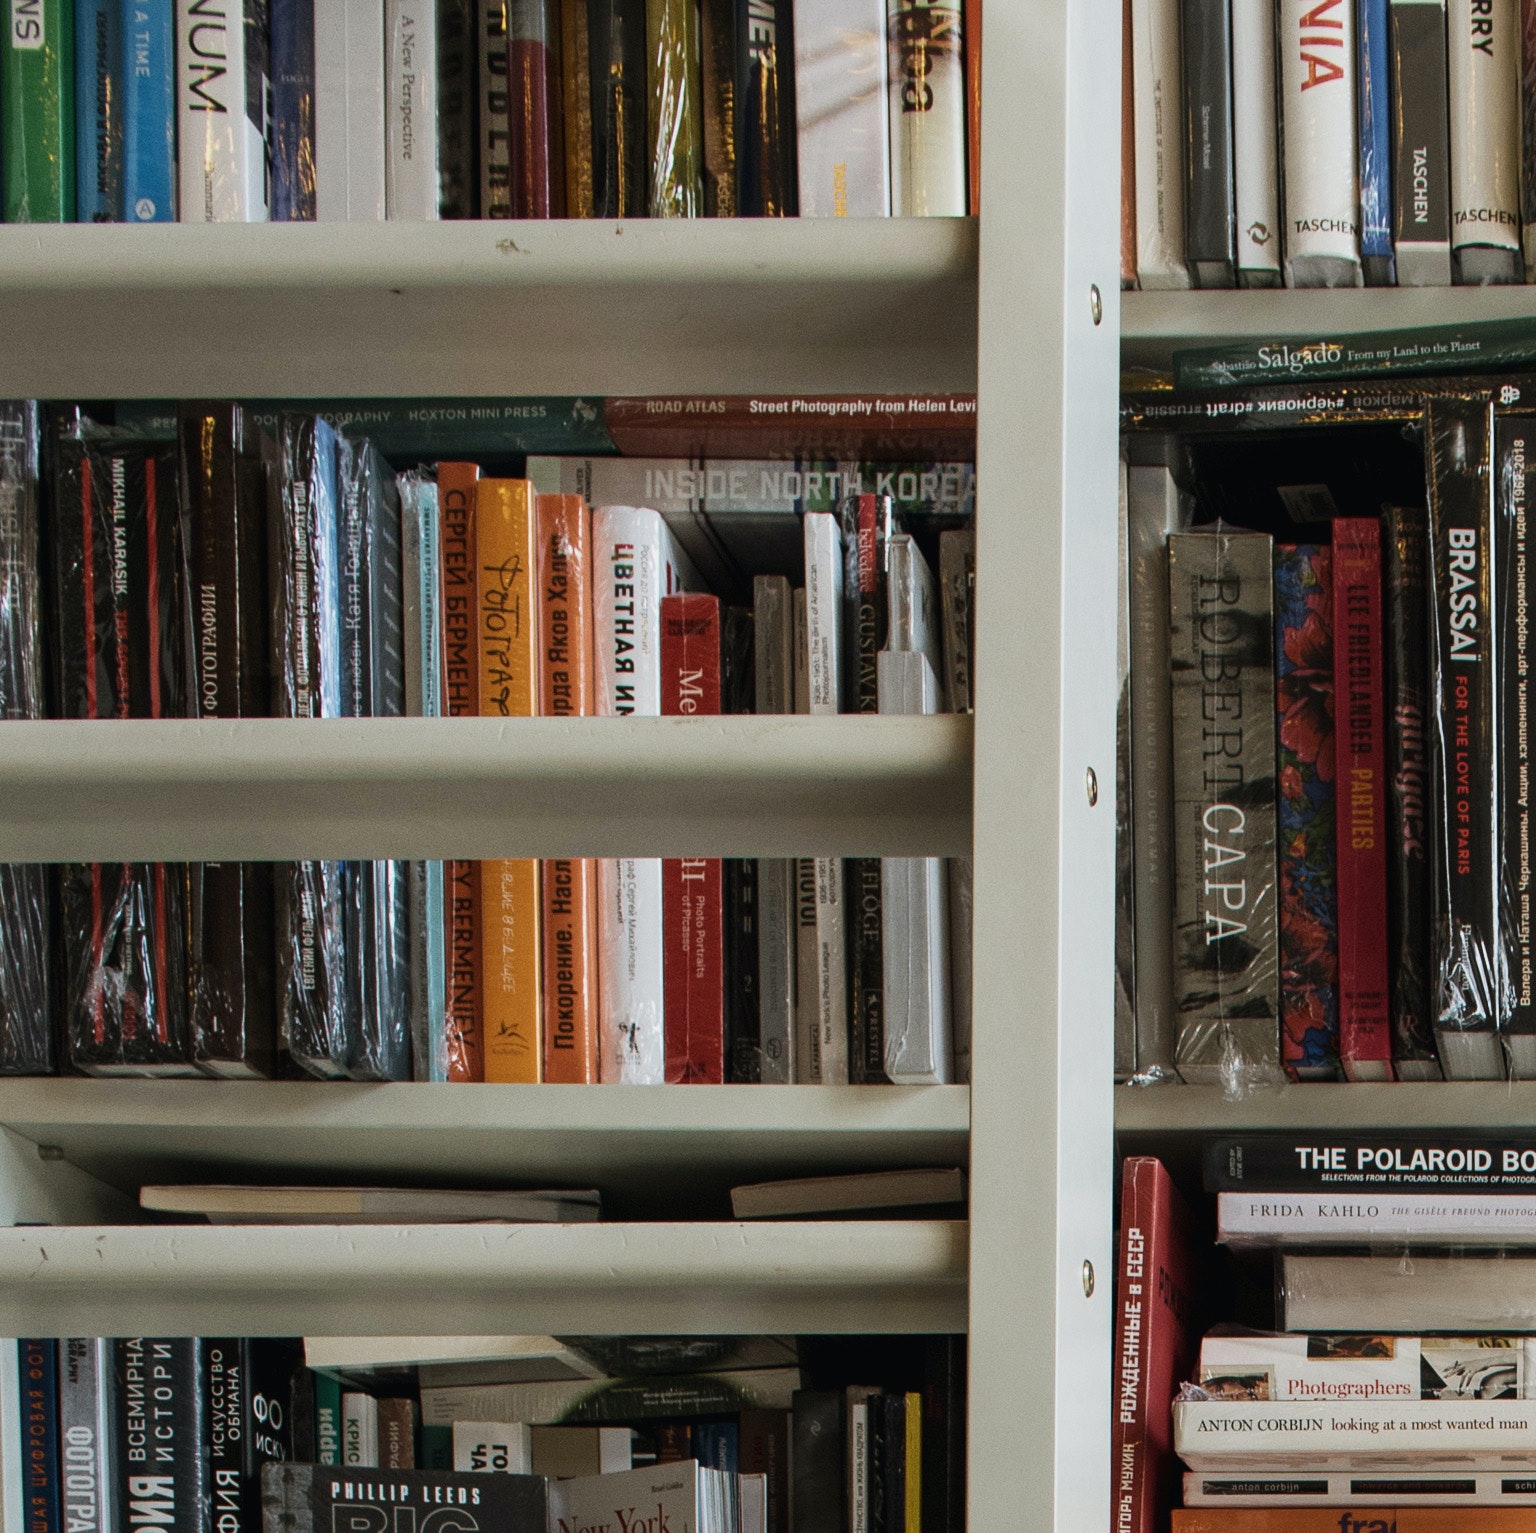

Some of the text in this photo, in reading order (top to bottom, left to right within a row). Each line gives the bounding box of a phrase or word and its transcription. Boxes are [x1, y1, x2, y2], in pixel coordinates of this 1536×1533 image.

[1412, 146, 1428, 224] TASCHEN
[1257, 343, 1341, 373] Salgado
[749, 399, 945, 416] Street Photography from Helen
[112, 458, 124, 523] MIKHAIL
[112, 526, 128, 596] KARASIK
[613, 544, 635, 673] ЦВЕТНАЯ
[1449, 527, 1482, 662] BRASSAÏ
[1295, 1147, 1348, 1172] THE
[1357, 1148, 1493, 1172] POLAROID
[1250, 1203, 1380, 1217] FRIDA KAHLO
[1128, 1227, 1144, 1276] СССР
[1120, 1300, 1144, 1423] РОЖДЕННЫЕ
[1287, 1378, 1411, 1400] Photographers
[1198, 1417, 1529, 1436] ANTON CORBIJN looking at a most wanted man
[1121, 1441, 1136, 1487] МУХИН
[331, 1483, 481, 1506] PHILLIP LEEDS
